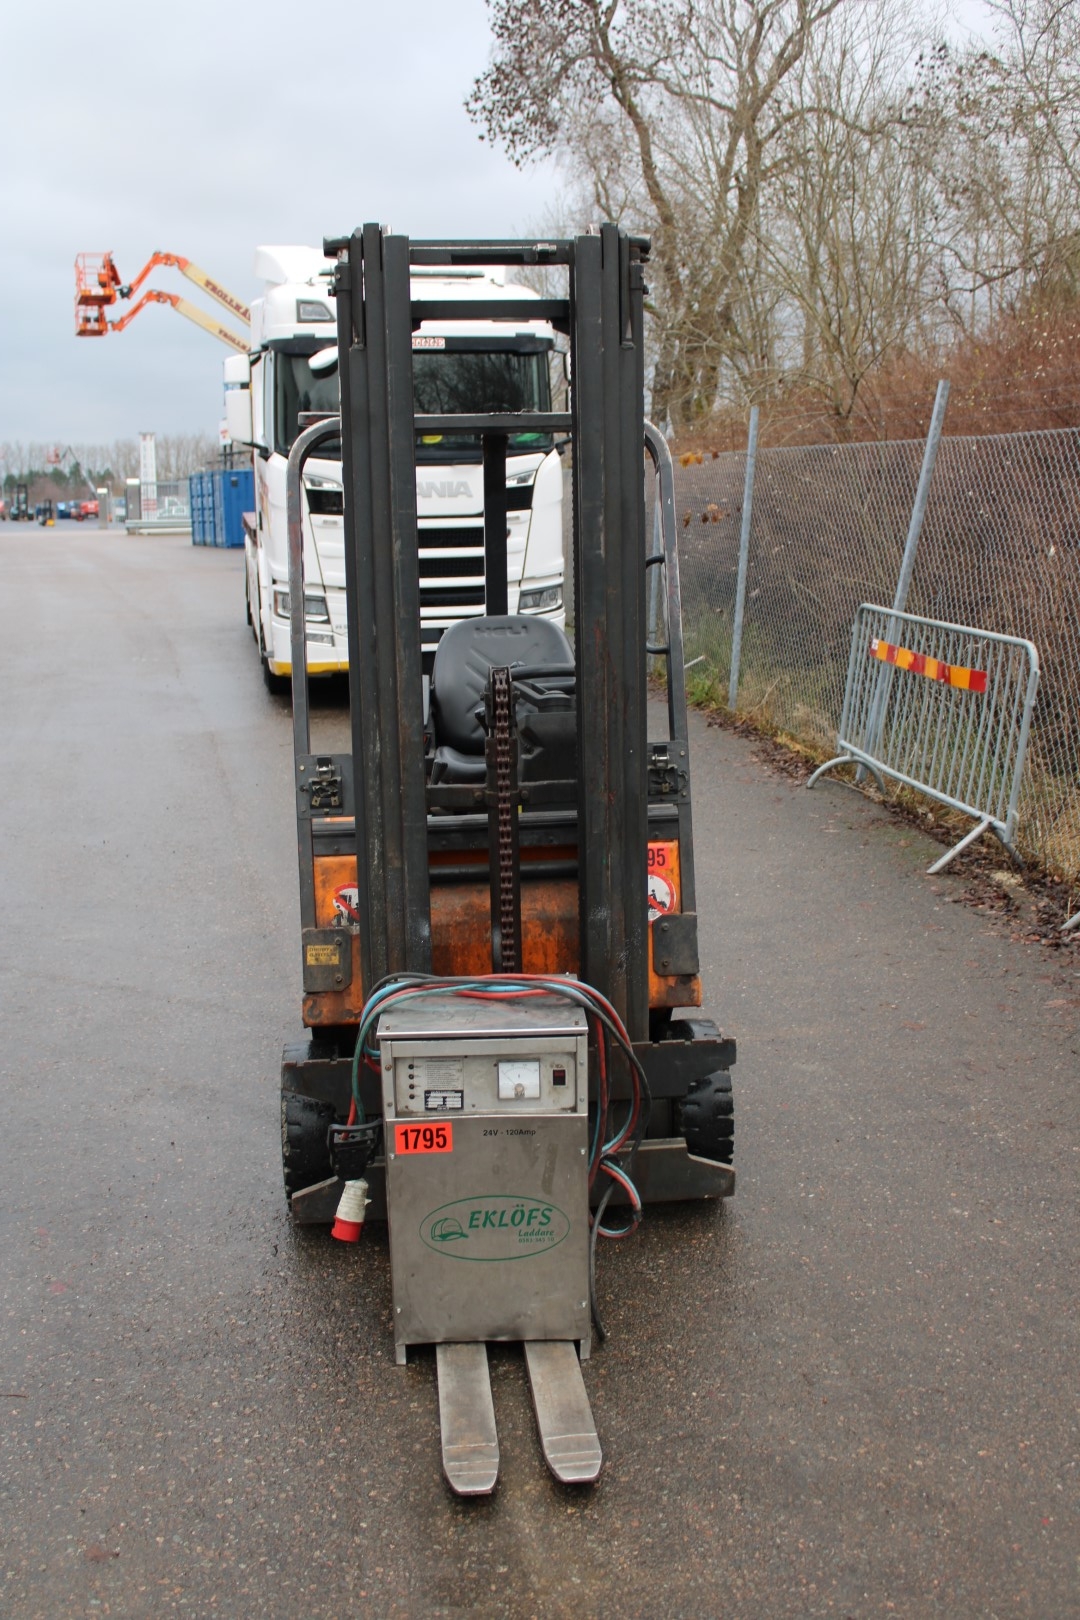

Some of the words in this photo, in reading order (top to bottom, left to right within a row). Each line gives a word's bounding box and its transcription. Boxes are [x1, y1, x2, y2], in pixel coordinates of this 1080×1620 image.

[416, 480, 474, 498] ANIA
[647, 848, 666, 867] 95
[400, 1127, 447, 1150] 1795
[483, 1129, 499, 1137] 24V
[506, 1128, 537, 1137] 120Amp
[468, 1204, 554, 1230] EKLÖFS
[518, 1228, 555, 1238] Laddare
